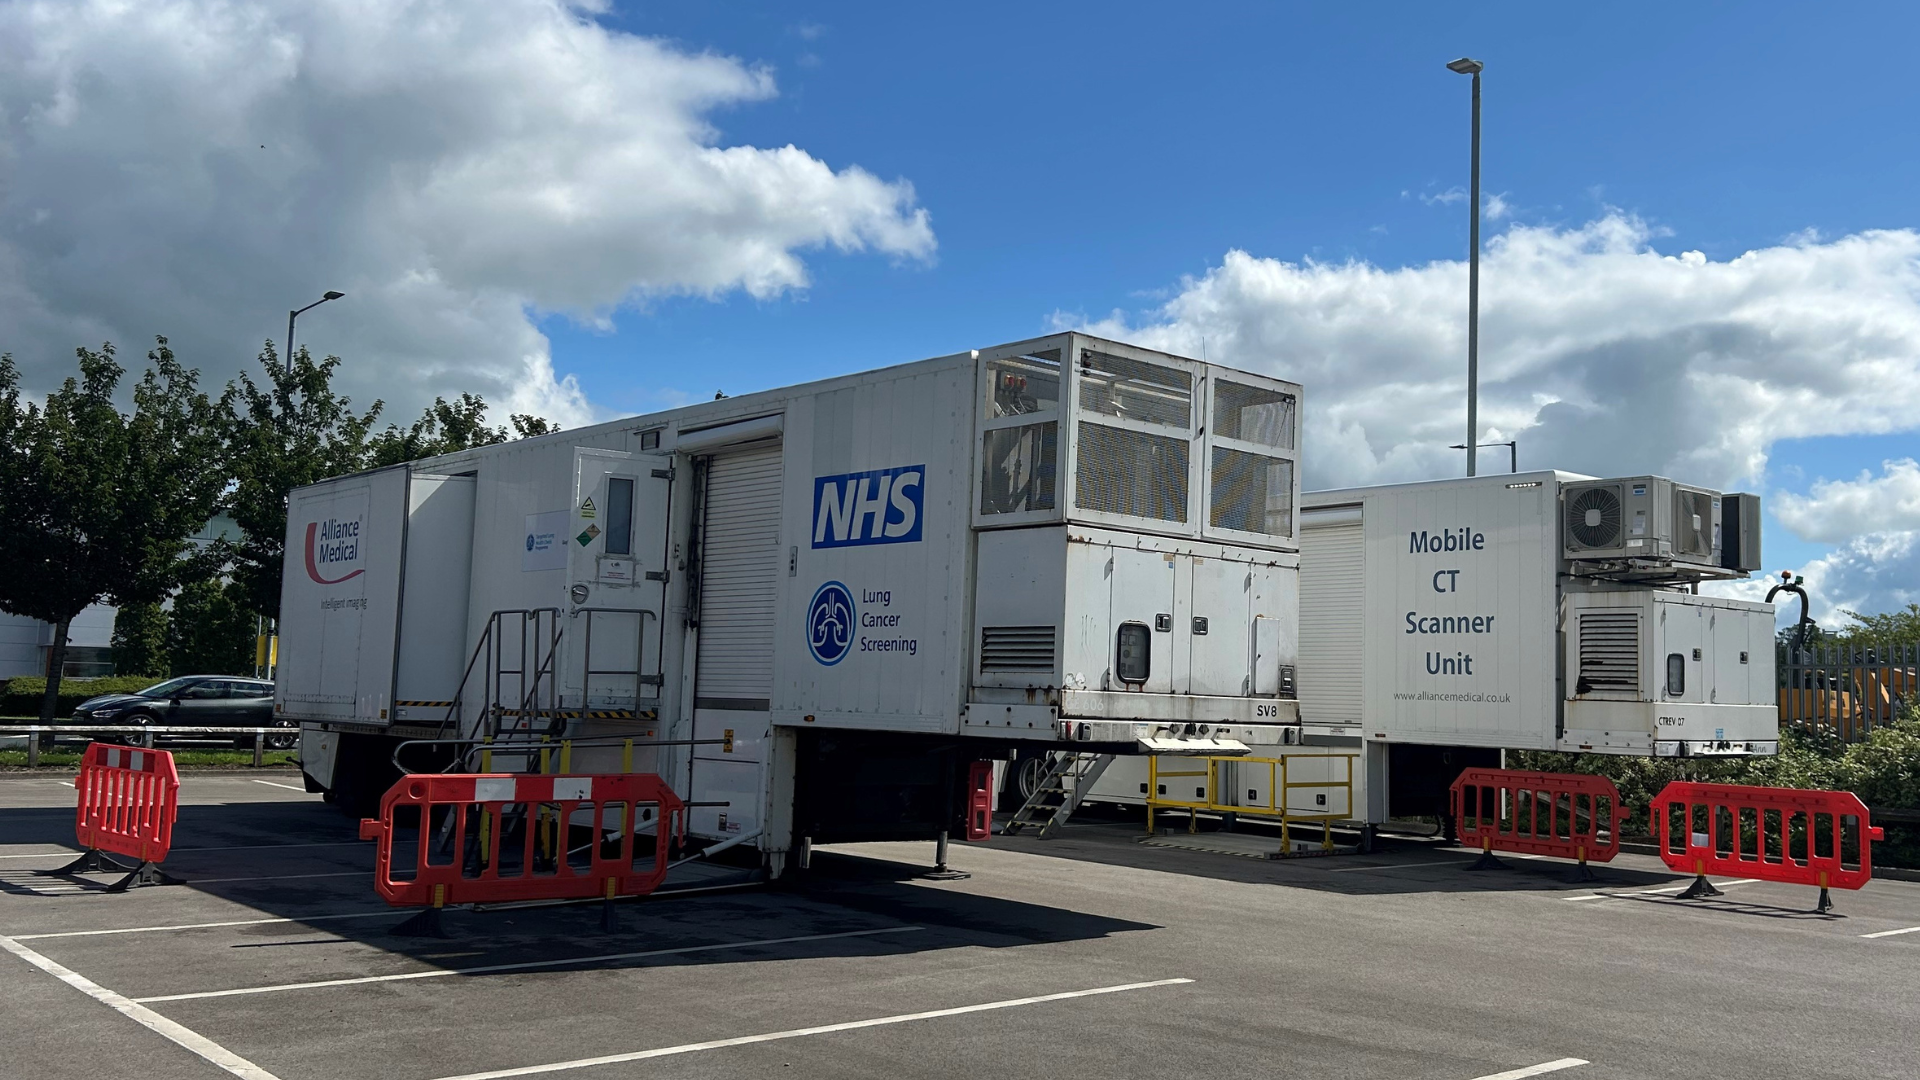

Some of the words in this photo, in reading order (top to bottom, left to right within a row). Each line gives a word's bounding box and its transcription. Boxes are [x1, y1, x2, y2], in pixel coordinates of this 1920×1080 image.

[814, 471, 921, 543] NHS
[320, 518, 359, 541] Alliance
[1409, 526, 1485, 554] Mobile
[319, 538, 358, 563] Medical
[1432, 569, 1461, 593] CT
[320, 597, 346, 612] Intelligent
[346, 596, 368, 611] imagng
[862, 588, 891, 607] Lung
[861, 612, 900, 628] Cancer
[1405, 611, 1495, 634] Scanner
[860, 633, 917, 656] Screening
[1426, 651, 1473, 676] Unit
[1083, 698, 1104, 711] 606
[1393, 690, 1511, 703] www.alliancemedical.co.uk
[1256, 704, 1277, 717] SV8
[1658, 716, 1676, 726] CTREV
[1678, 717, 1685, 726] 07
